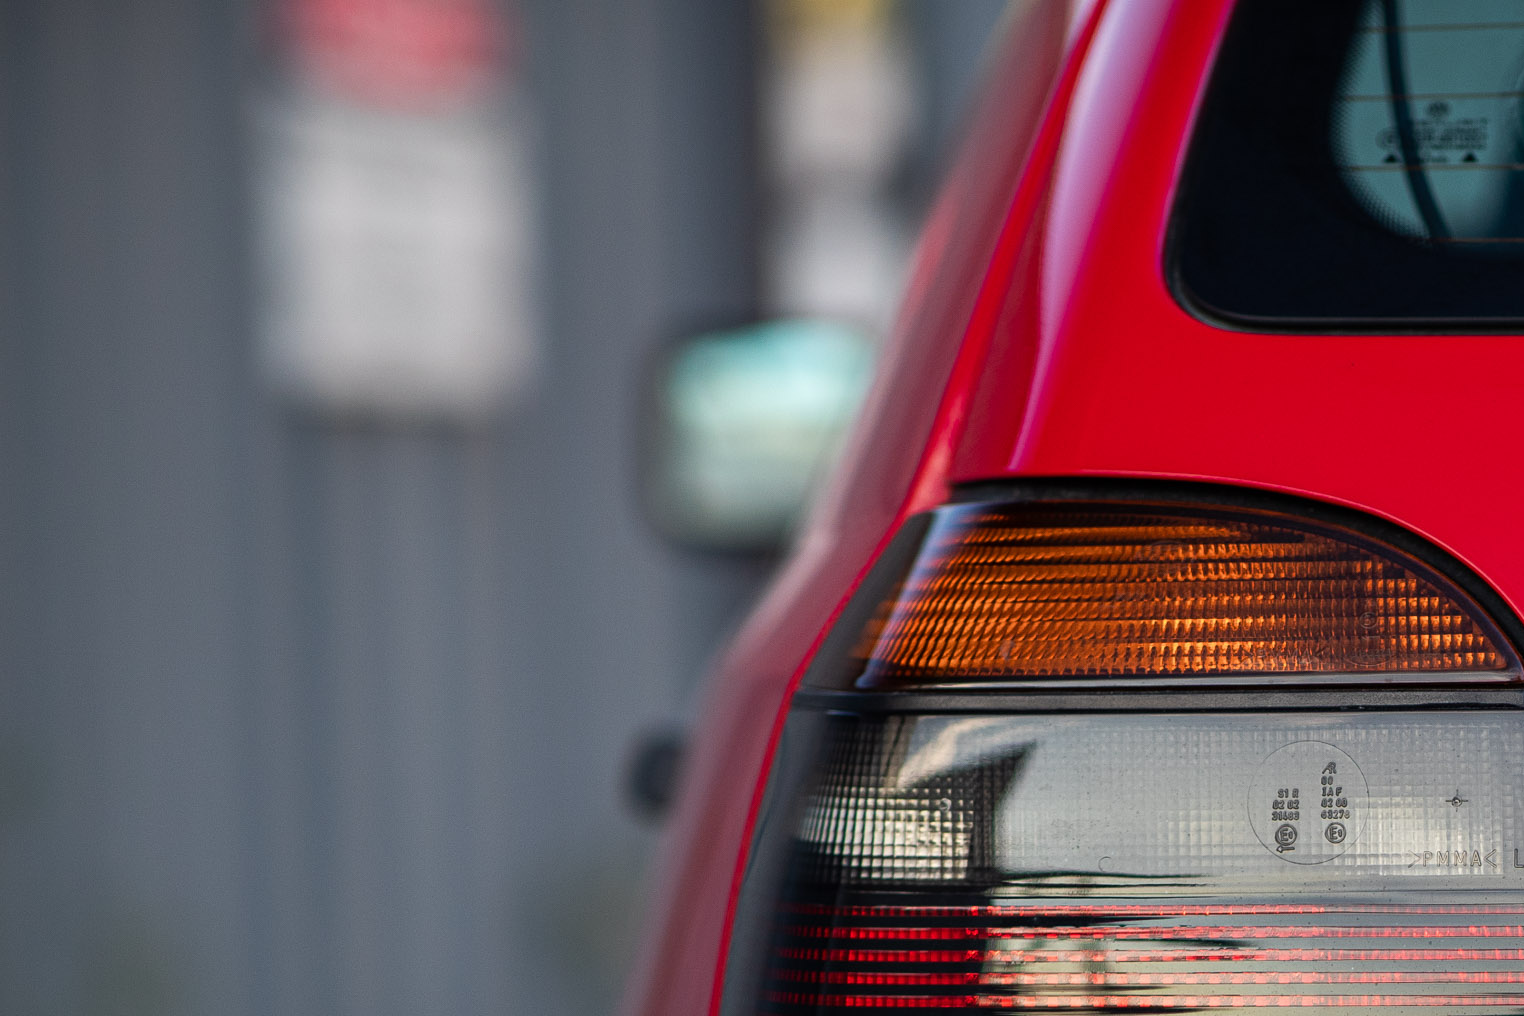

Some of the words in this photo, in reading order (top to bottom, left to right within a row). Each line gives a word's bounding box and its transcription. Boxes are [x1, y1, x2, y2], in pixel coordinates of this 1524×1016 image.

[1272, 799, 1285, 810] 02
[1287, 799, 1300, 810] 02
[1513, 848, 1524, 868] L
